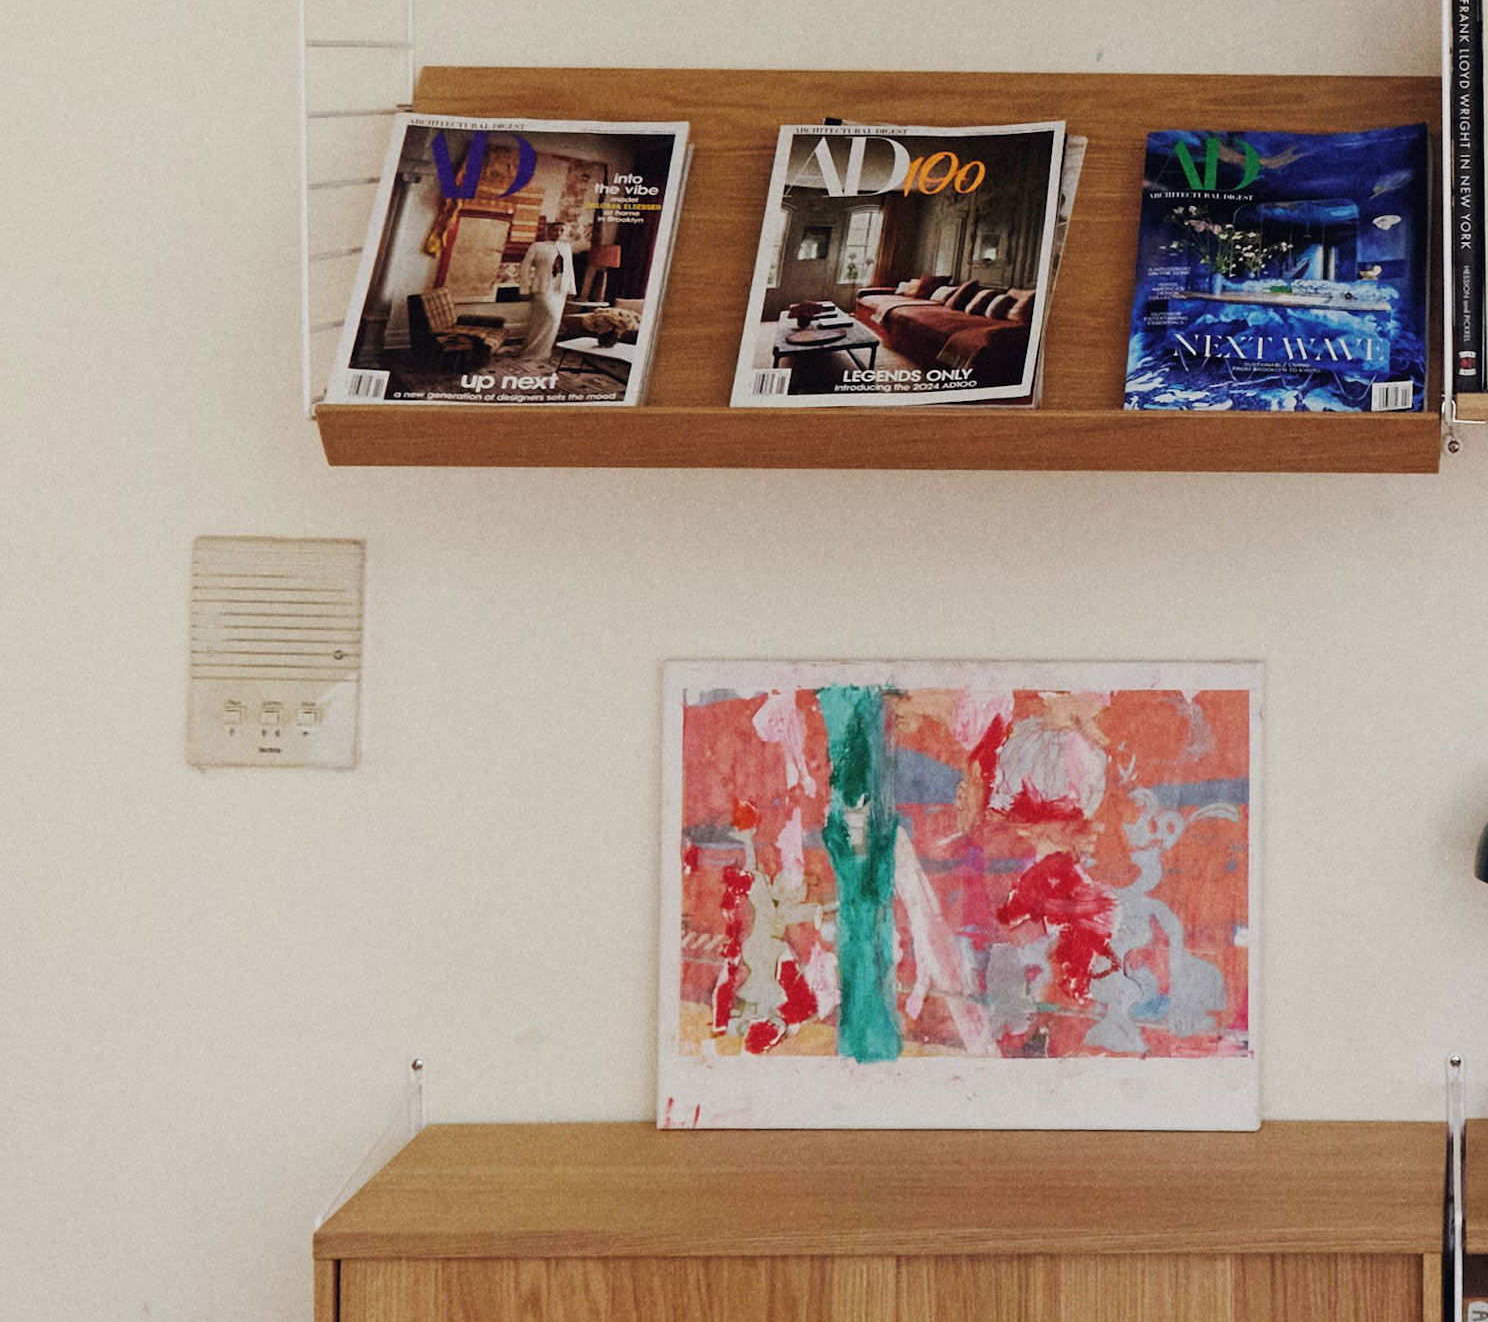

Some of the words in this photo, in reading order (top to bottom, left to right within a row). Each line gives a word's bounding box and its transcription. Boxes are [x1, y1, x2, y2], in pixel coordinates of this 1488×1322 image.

[1459, 48, 1470, 89] LLOYD
[1459, 93, 1471, 149] WRIGHT
[1460, 154, 1471, 169] IN
[613, 173, 643, 184] into
[595, 183, 620, 195] the
[624, 184, 659, 195] vibe
[1460, 175, 1472, 205] NEW
[1460, 209, 1472, 250] YORK
[1172, 334, 1274, 360] NEXT
[1282, 338, 1385, 361] WAVE
[460, 373, 494, 393] up
[501, 372, 559, 390] next
[842, 369, 922, 383] LEGENDS
[925, 368, 974, 381] ONLY
[834, 383, 891, 392] introducing
[894, 383, 911, 391] the
[913, 382, 939, 390] 2024
[941, 380, 978, 388] AD100
[427, 391, 482, 402] generation
[496, 392, 544, 403] designers
[546, 393, 566, 402] sets
[567, 392, 584, 401] the
[586, 392, 616, 400] mood
